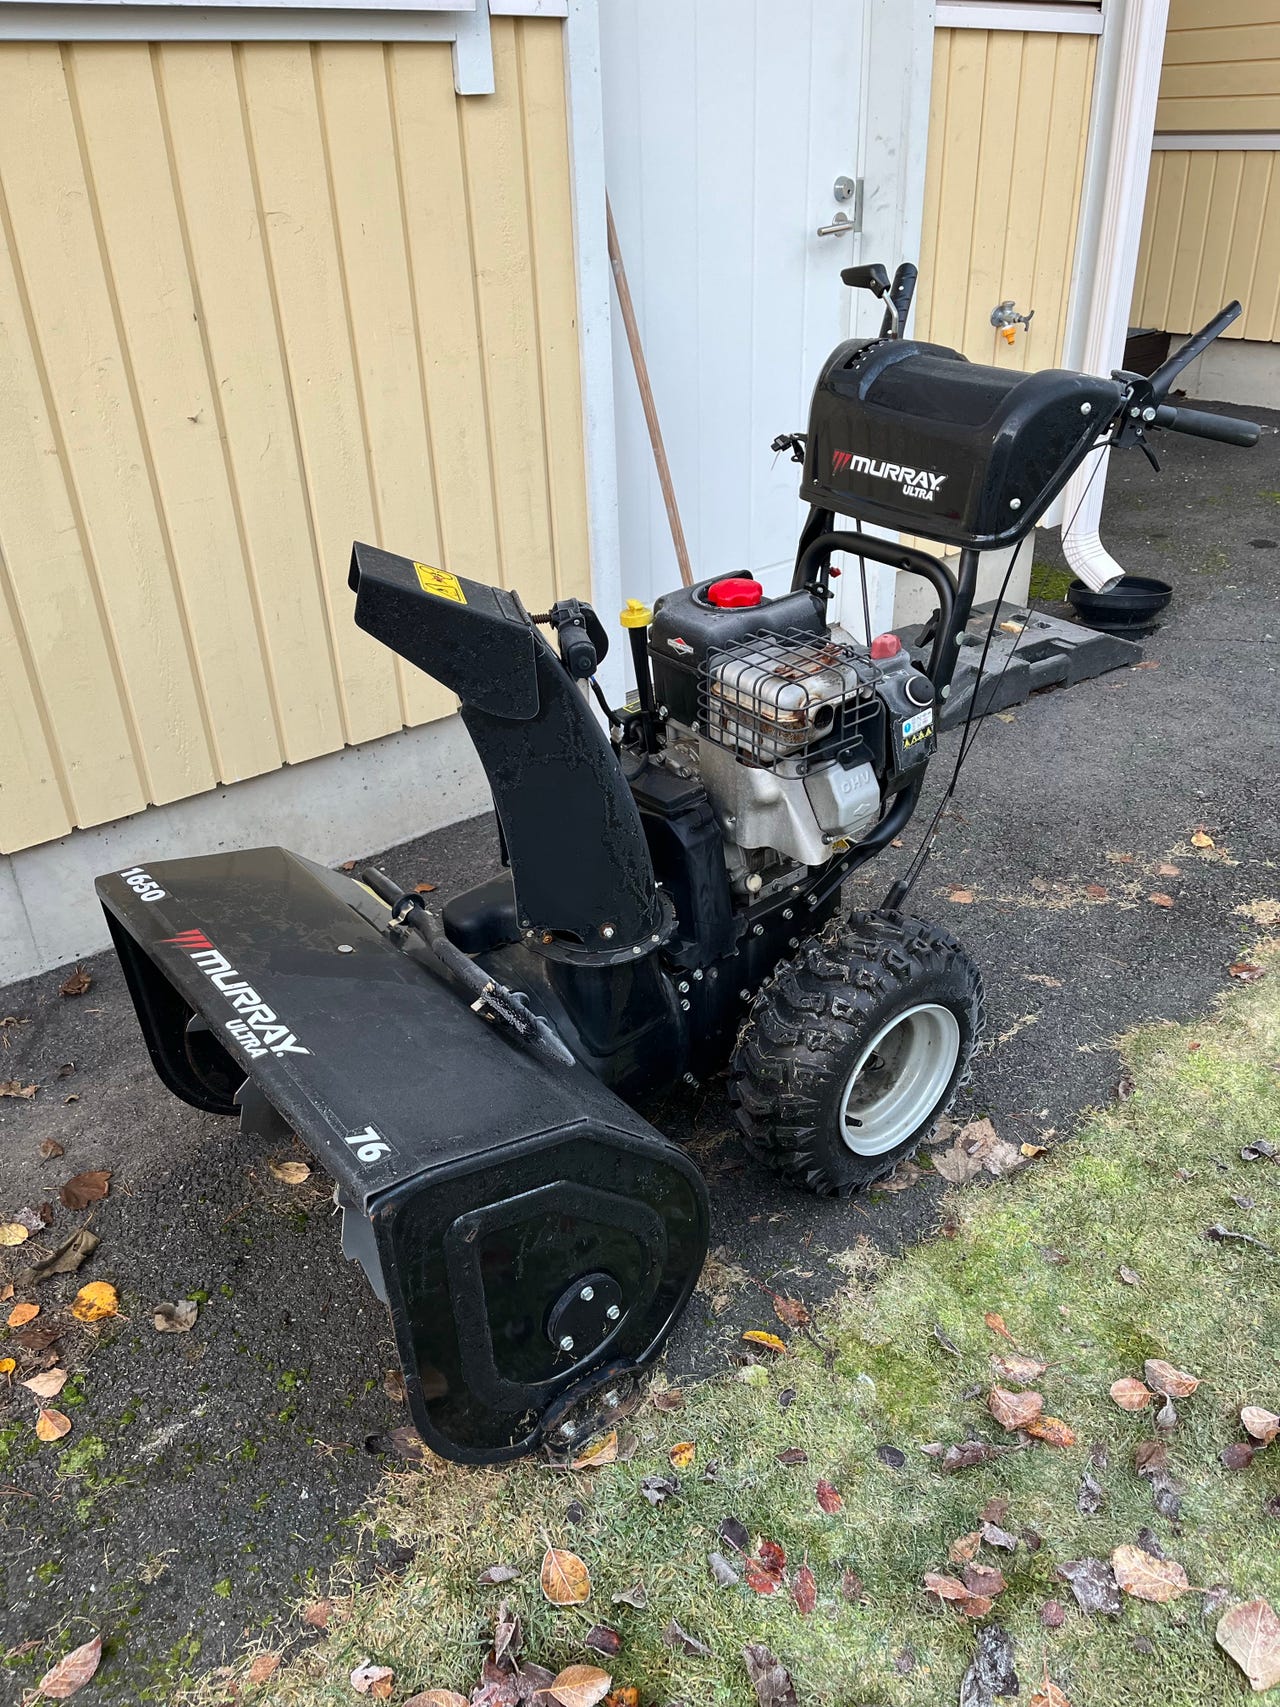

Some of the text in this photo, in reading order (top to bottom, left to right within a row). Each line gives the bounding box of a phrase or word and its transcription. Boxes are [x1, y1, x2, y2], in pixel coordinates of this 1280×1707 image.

[903, 485, 933, 502] ULTRA
[841, 770, 870, 793] OHV
[120, 867, 165, 902] 1650
[225, 1019, 268, 1058] ULTRA
[344, 1126, 391, 1162] 76
